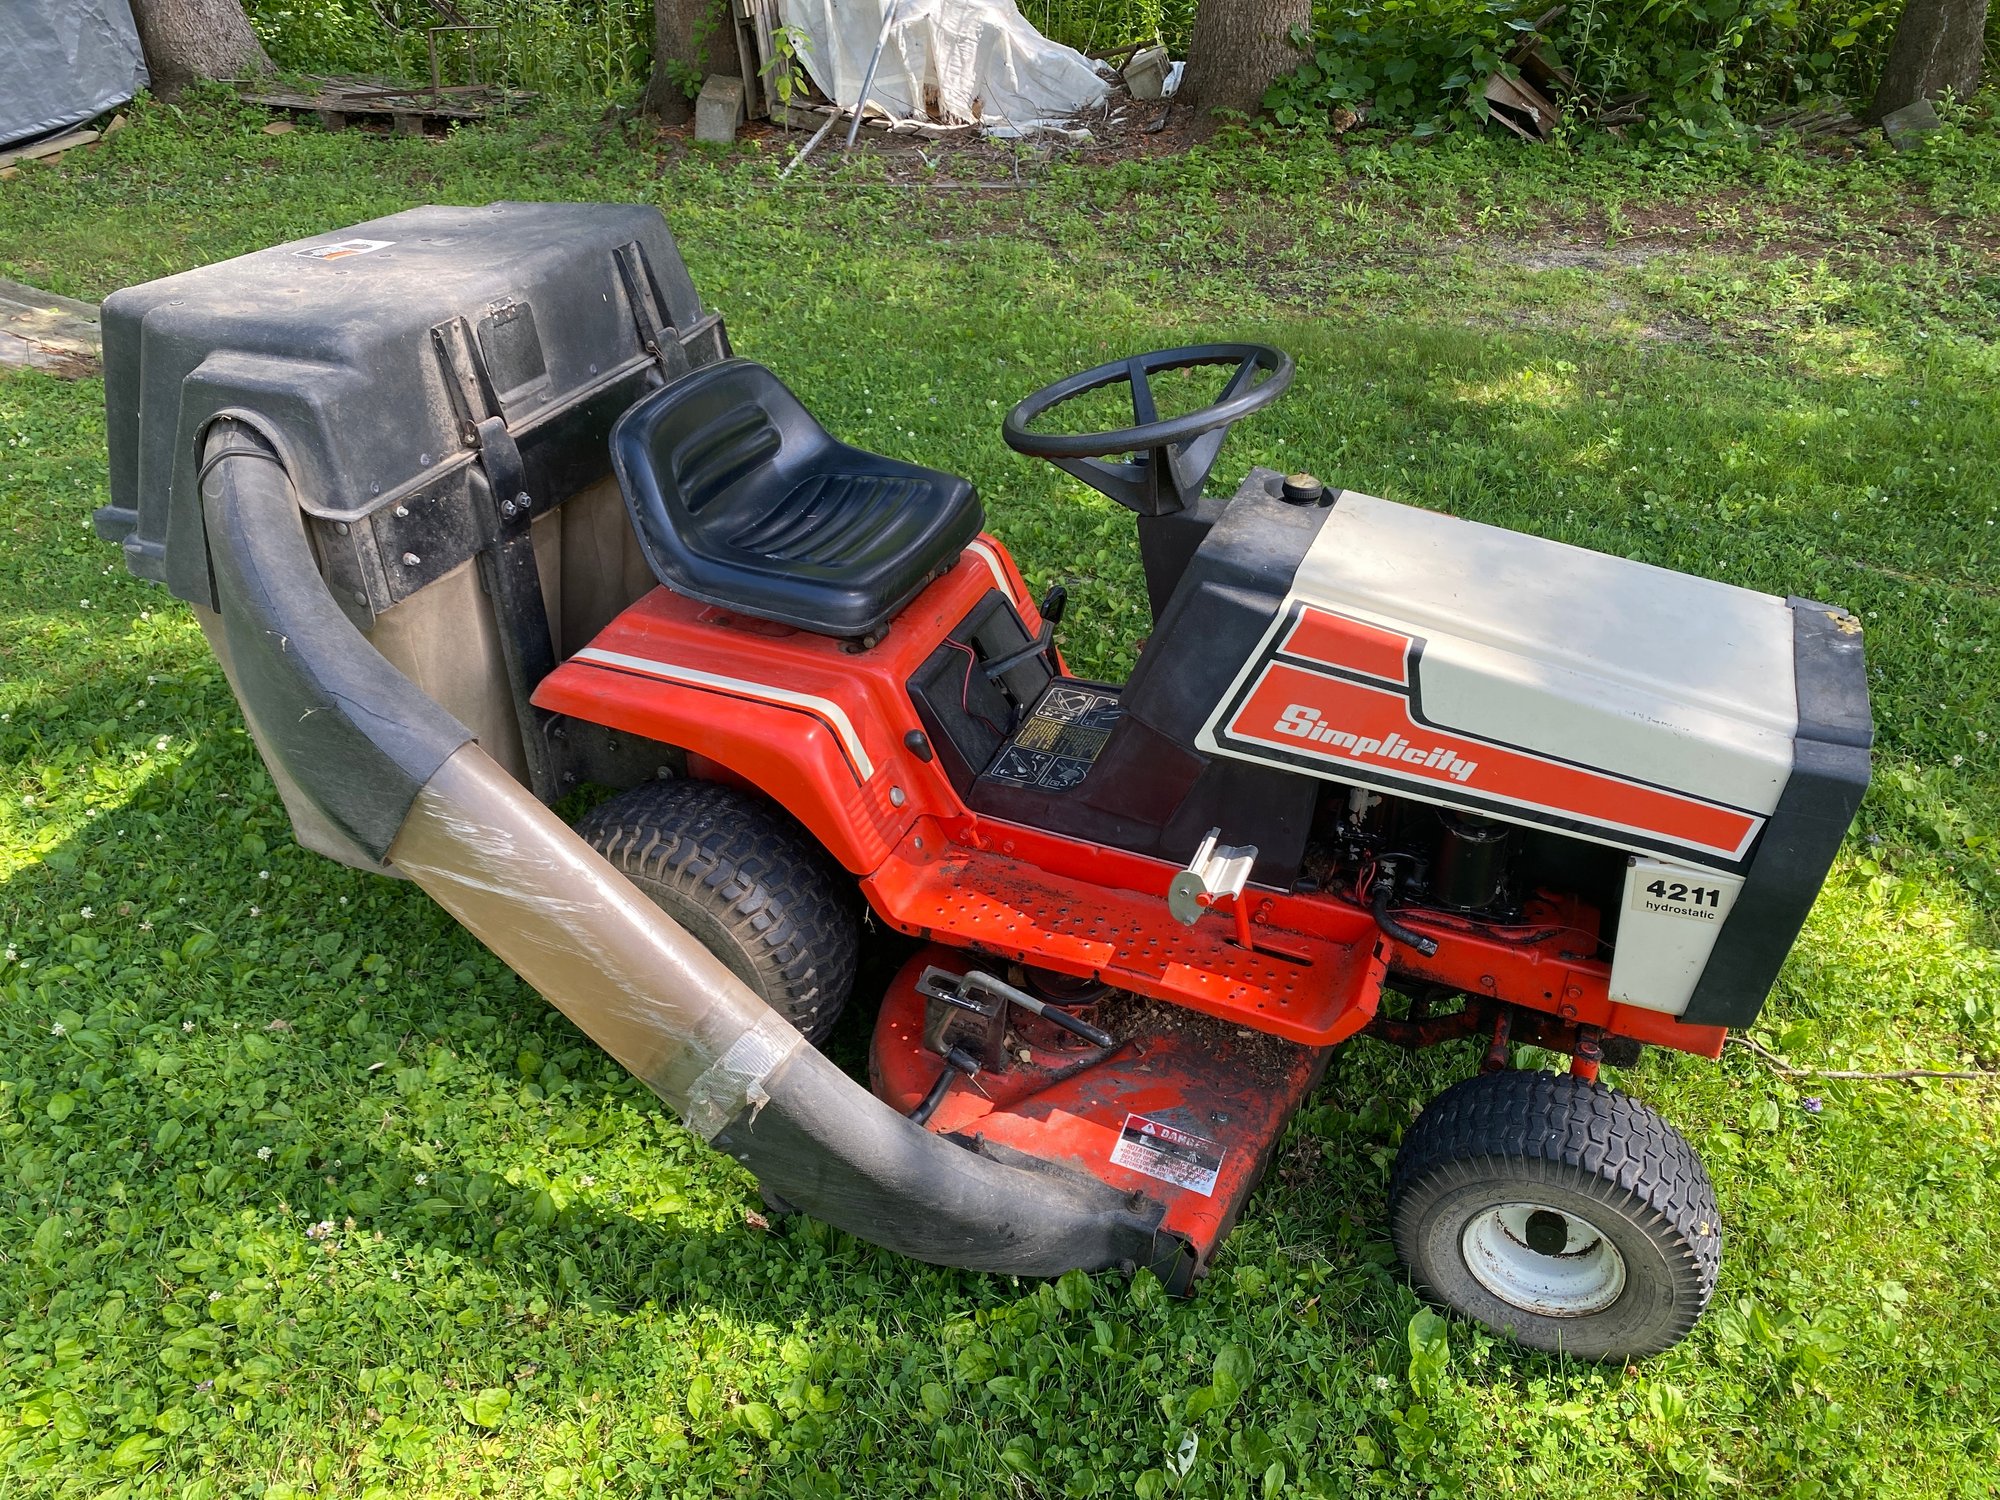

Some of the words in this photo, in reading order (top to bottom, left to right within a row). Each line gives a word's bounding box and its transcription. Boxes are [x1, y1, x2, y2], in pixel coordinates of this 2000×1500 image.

[1273, 703, 1479, 782] Simplicity
[1646, 880, 1720, 908] 4211
[1646, 900, 1715, 920] hydrostatic
